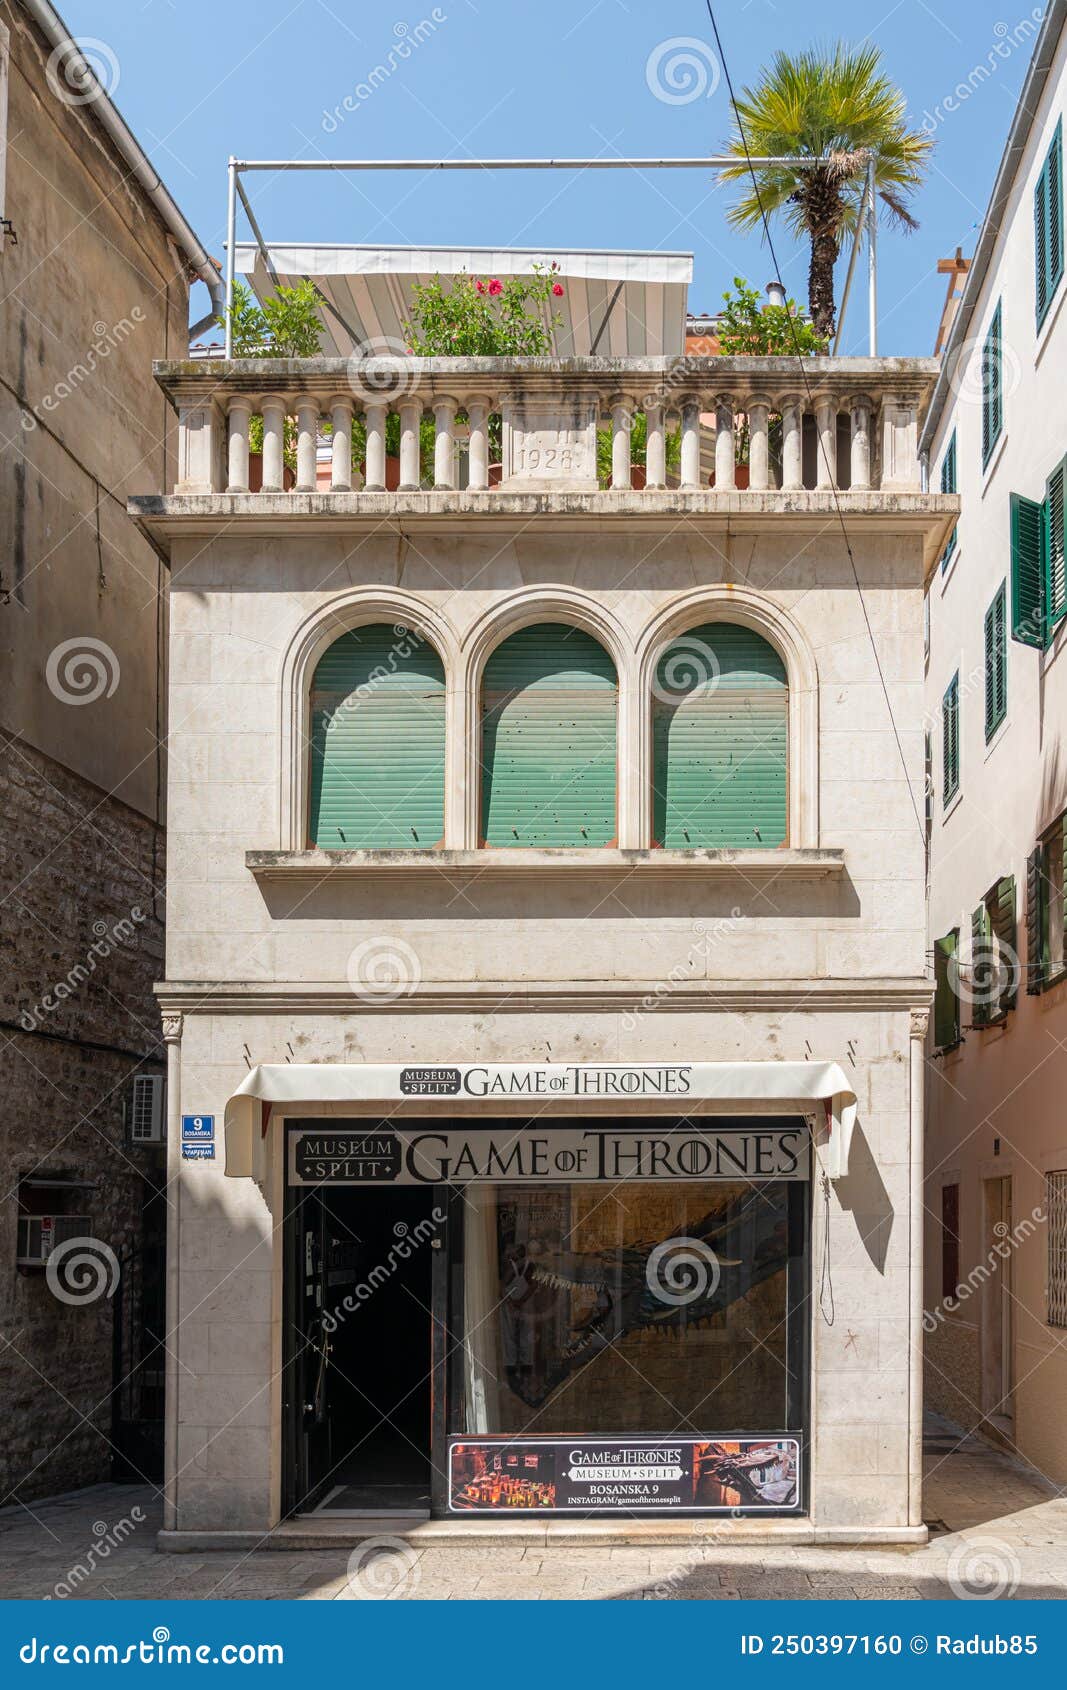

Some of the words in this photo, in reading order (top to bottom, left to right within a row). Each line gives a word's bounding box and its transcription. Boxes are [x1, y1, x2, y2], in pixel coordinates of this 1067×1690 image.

[520, 449, 572, 470] 1928
[404, 1071, 457, 1081] MUSEUM
[463, 1068, 547, 1096] GAME
[549, 1077, 570, 1091] OF
[566, 1067, 692, 1095] THRONES
[410, 1083, 450, 1093] SPLIT
[193, 1118, 203, 1131] 9
[305, 1141, 392, 1155] MUSEUM
[405, 1134, 550, 1184] GAME
[554, 1149, 588, 1172] OF
[583, 1129, 802, 1180] THRONES
[315, 1162, 381, 1177] SPLIT
[569, 1450, 611, 1466] GAME
[620, 1449, 682, 1464] THRONES
[576, 1469, 632, 1479] MUSEUM
[639, 1468, 676, 1478] SPLIT
[589, 1485, 649, 1495] BOSANSKA
[652, 1484, 659, 1494] 9
[568, 1495, 681, 1505] INSTAGRAM/gameofthronessplit
